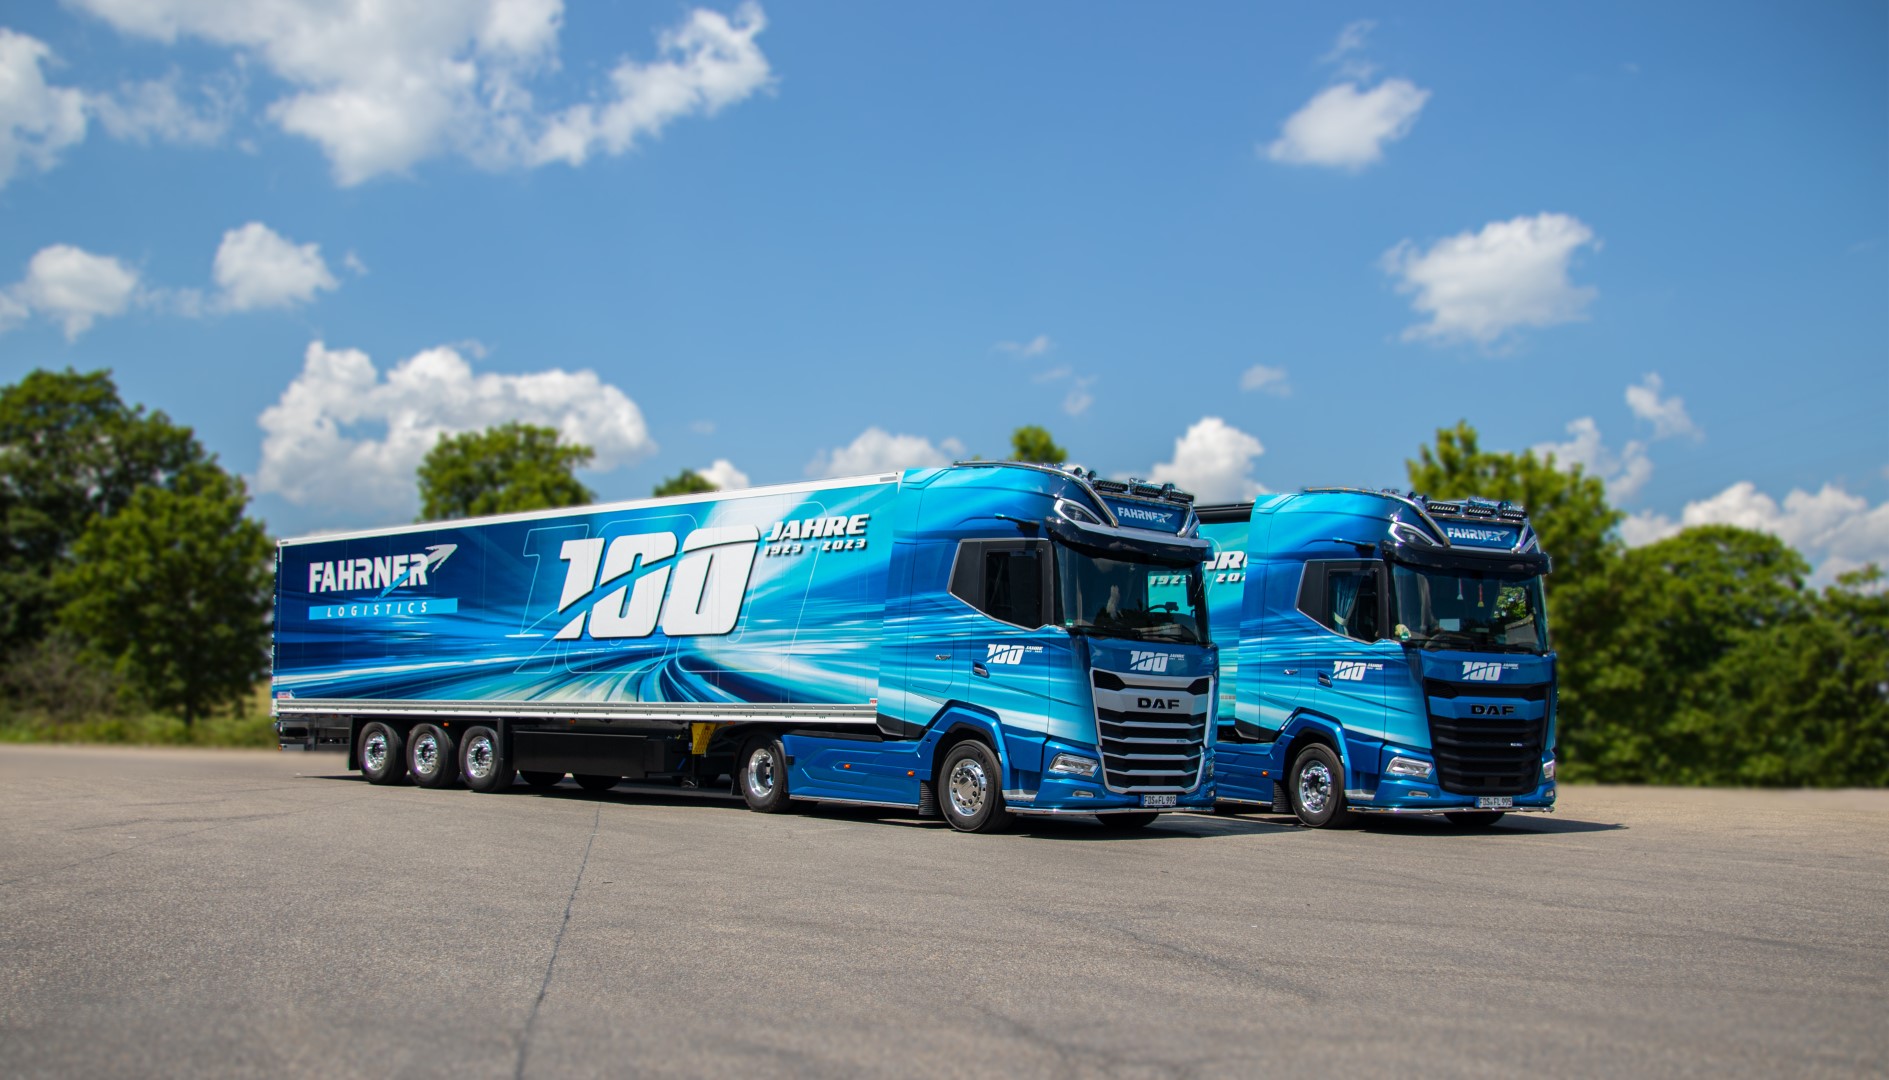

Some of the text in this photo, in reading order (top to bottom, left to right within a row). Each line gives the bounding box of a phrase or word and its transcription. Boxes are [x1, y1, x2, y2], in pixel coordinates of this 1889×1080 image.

[1117, 507, 1166, 523] FAHRNER
[765, 514, 870, 541] JAHRE
[1447, 527, 1502, 542] FAHRNER
[765, 543, 803, 555] 1923
[821, 538, 867, 551] 2023
[308, 553, 429, 593] FAHRNER
[554, 525, 760, 639] 100
[327, 601, 428, 618] LOGISTICS
[986, 644, 1025, 665] 100
[1130, 650, 1169, 672] 100
[1332, 661, 1367, 681] 100
[1462, 661, 1502, 681] 100
[1137, 697, 1180, 710] DAF
[1471, 704, 1515, 716] DAF
